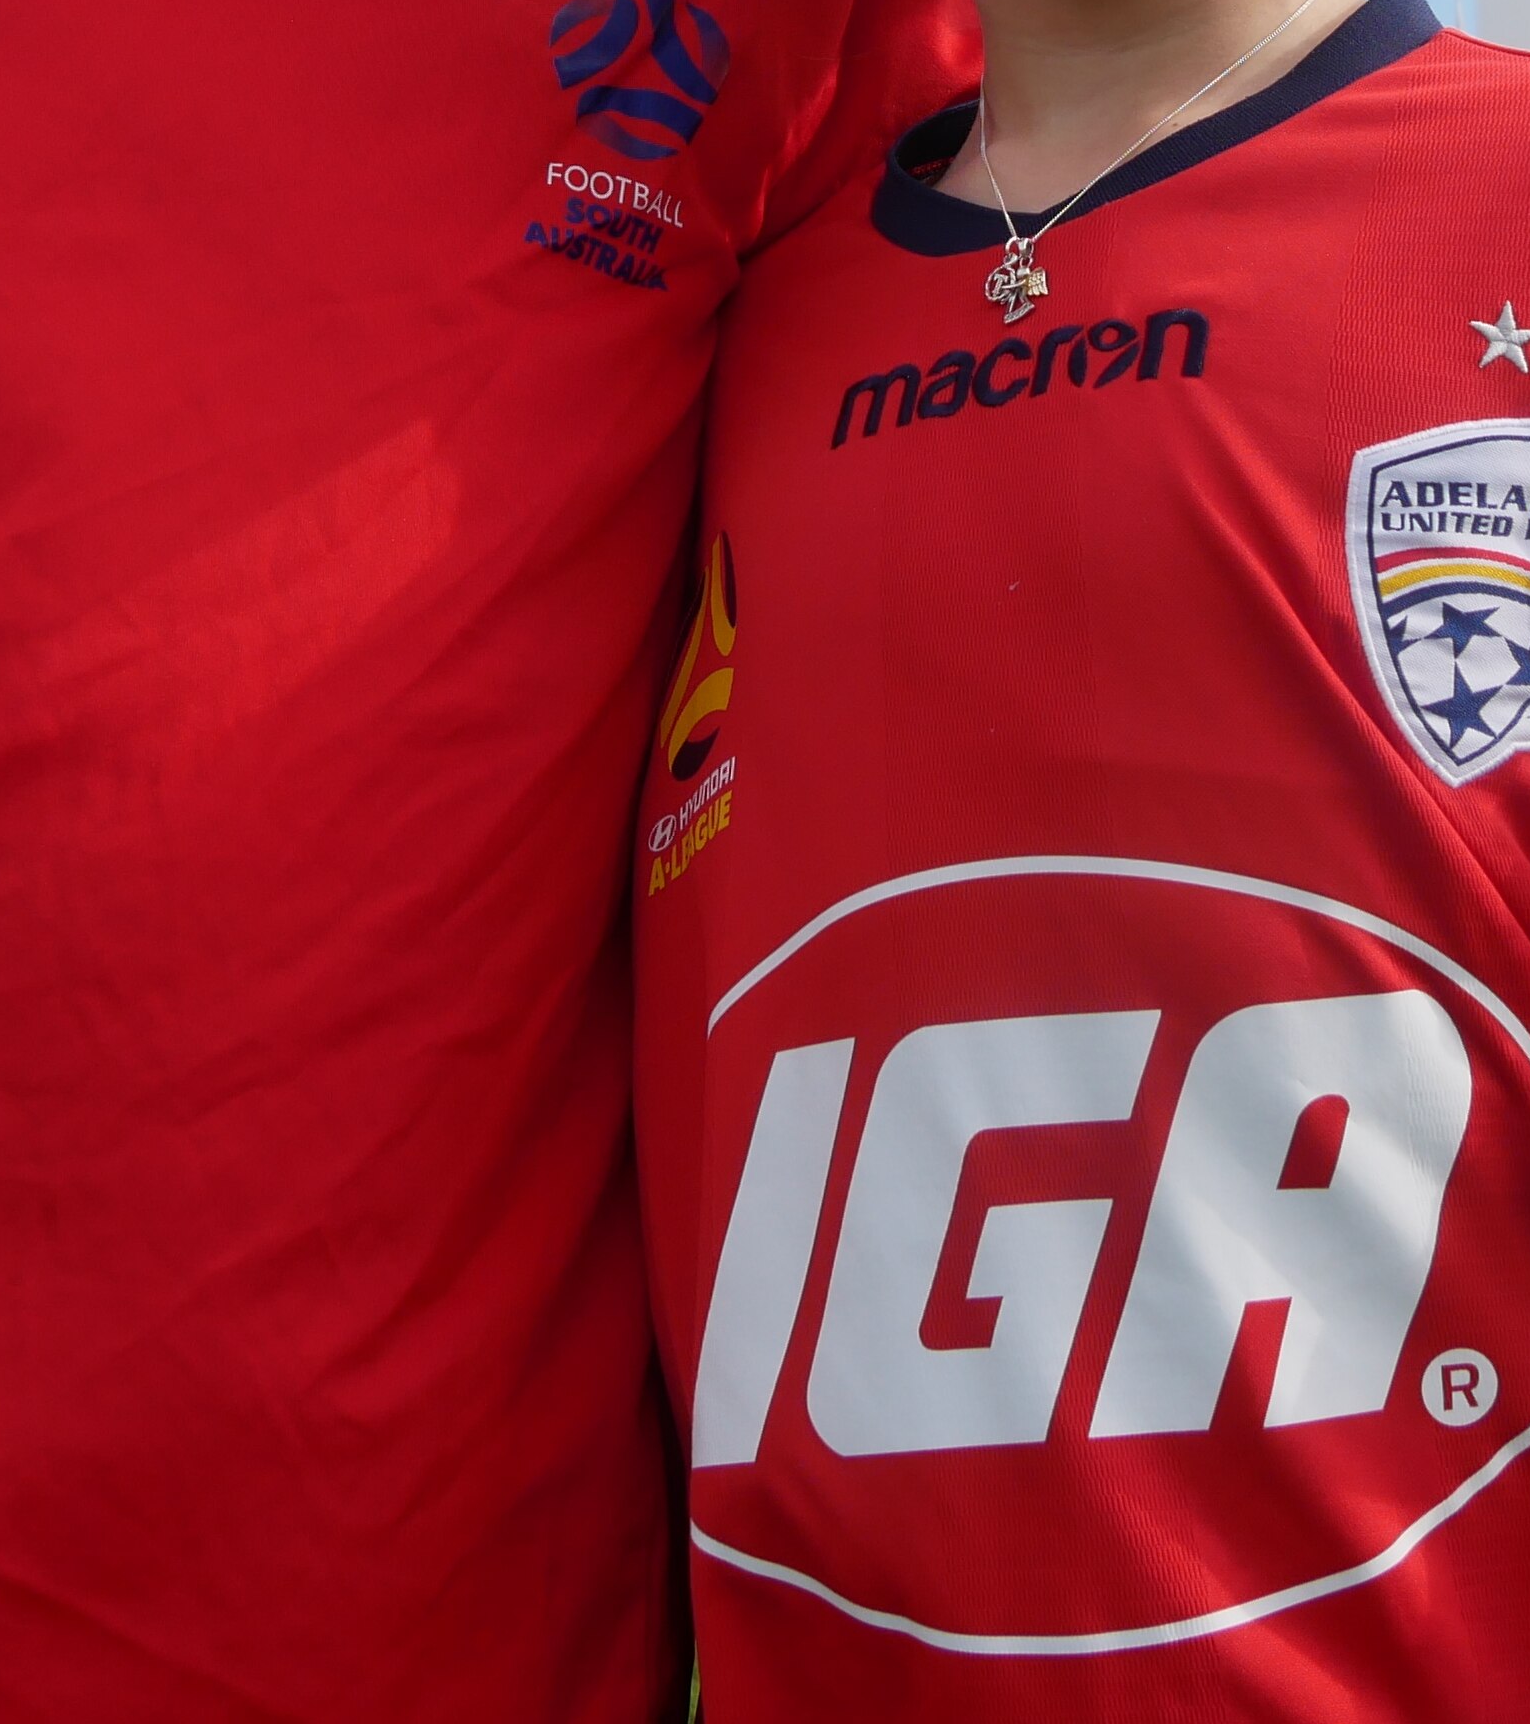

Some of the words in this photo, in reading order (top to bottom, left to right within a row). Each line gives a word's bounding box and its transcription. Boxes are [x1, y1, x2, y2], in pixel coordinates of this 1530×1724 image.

[546, 162, 684, 229] FOOTBALL
[565, 197, 665, 255] SOUTH
[524, 221, 669, 292] AUSTRALIA
[830, 307, 1210, 451] macron
[1380, 511, 1515, 538] UNITED
[679, 756, 736, 831] HYUNDAI
[692, 989, 1472, 1469] IGA
